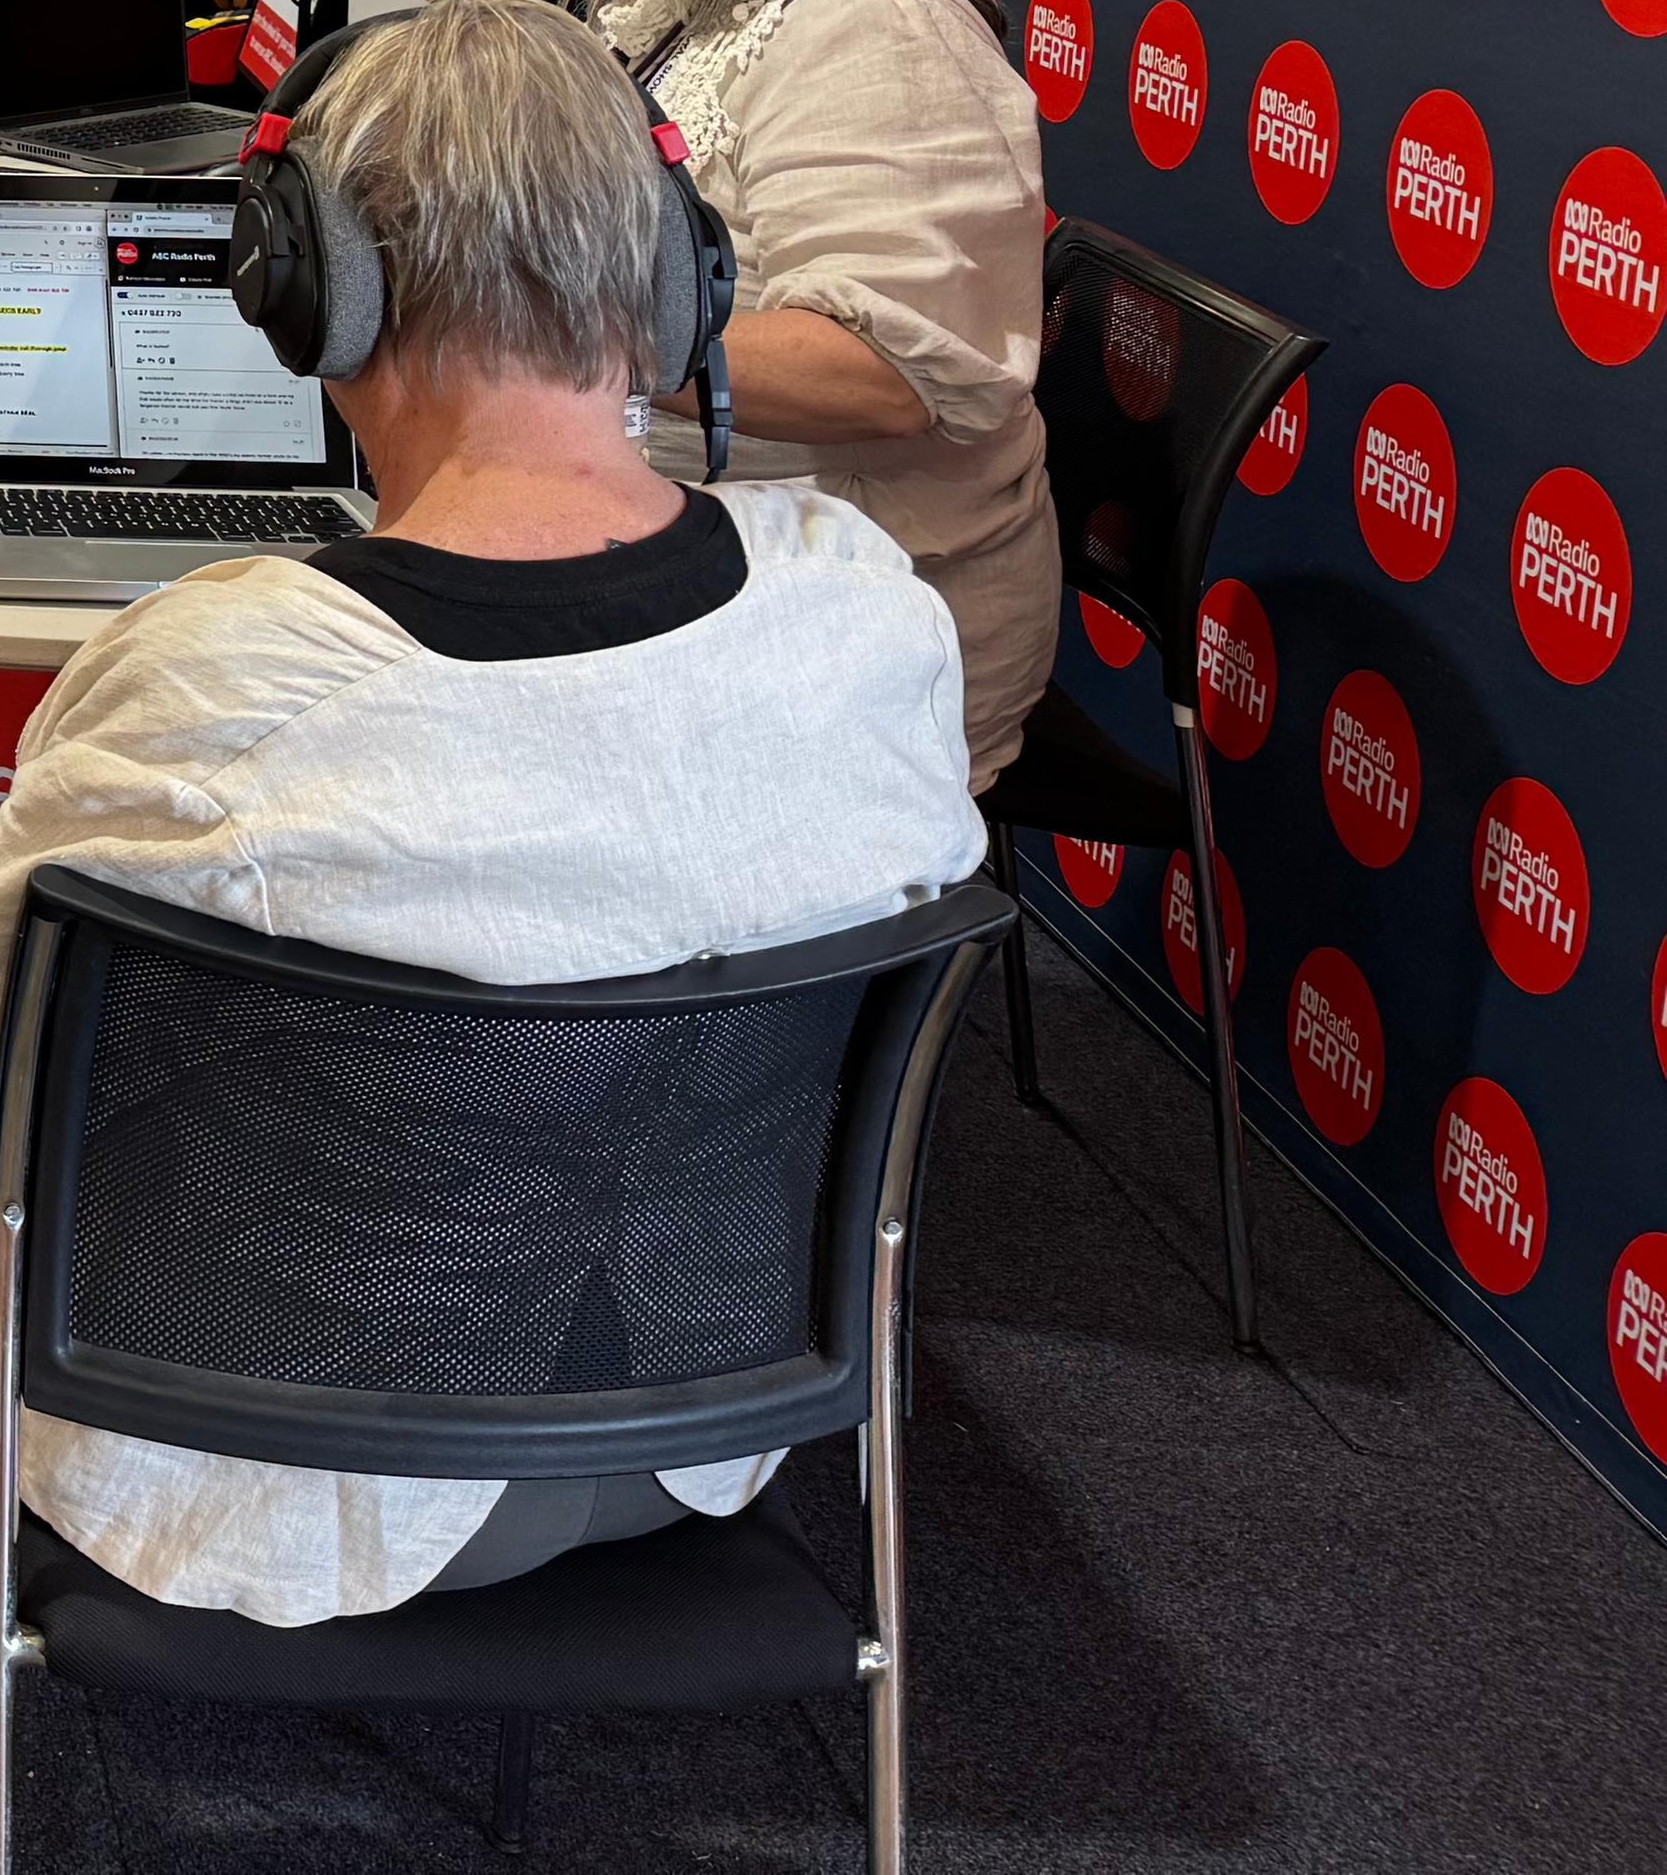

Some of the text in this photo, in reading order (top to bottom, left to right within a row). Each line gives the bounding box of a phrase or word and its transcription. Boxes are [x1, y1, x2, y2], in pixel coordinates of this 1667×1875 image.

[1047, 9, 1076, 39] Radio
[1030, 29, 1085, 81] PERTH
[1154, 48, 1187, 80] Radio
[1135, 68, 1198, 125] PERTH
[1277, 93, 1315, 129] Radio
[1255, 114, 1328, 178] PERTH
[1420, 145, 1465, 186] Radio
[1394, 167, 1480, 240] PERTH
[1589, 207, 1641, 253] Radio
[1558, 230, 1659, 313] PERTH
[122, 466, 136, 476] Pro
[1386, 437, 1429, 483] Radio
[1361, 455, 1444, 538] PERTH
[1549, 525, 1599, 576] Radio
[1520, 543, 1617, 638] PERTH
[1218, 626, 1253, 670] Radio
[1197, 641, 1265, 722] PERTH
[1352, 721, 1394, 771] Radio
[1328, 736, 1408, 829] PERTH
[1509, 833, 1558, 890] Radio
[1482, 848, 1575, 953] PERTH
[1318, 997, 1359, 1052] Radio
[1295, 1008, 1372, 1110] PERTH
[1470, 1131, 1517, 1193] Radio
[1443, 1142, 1533, 1259] PERTH
